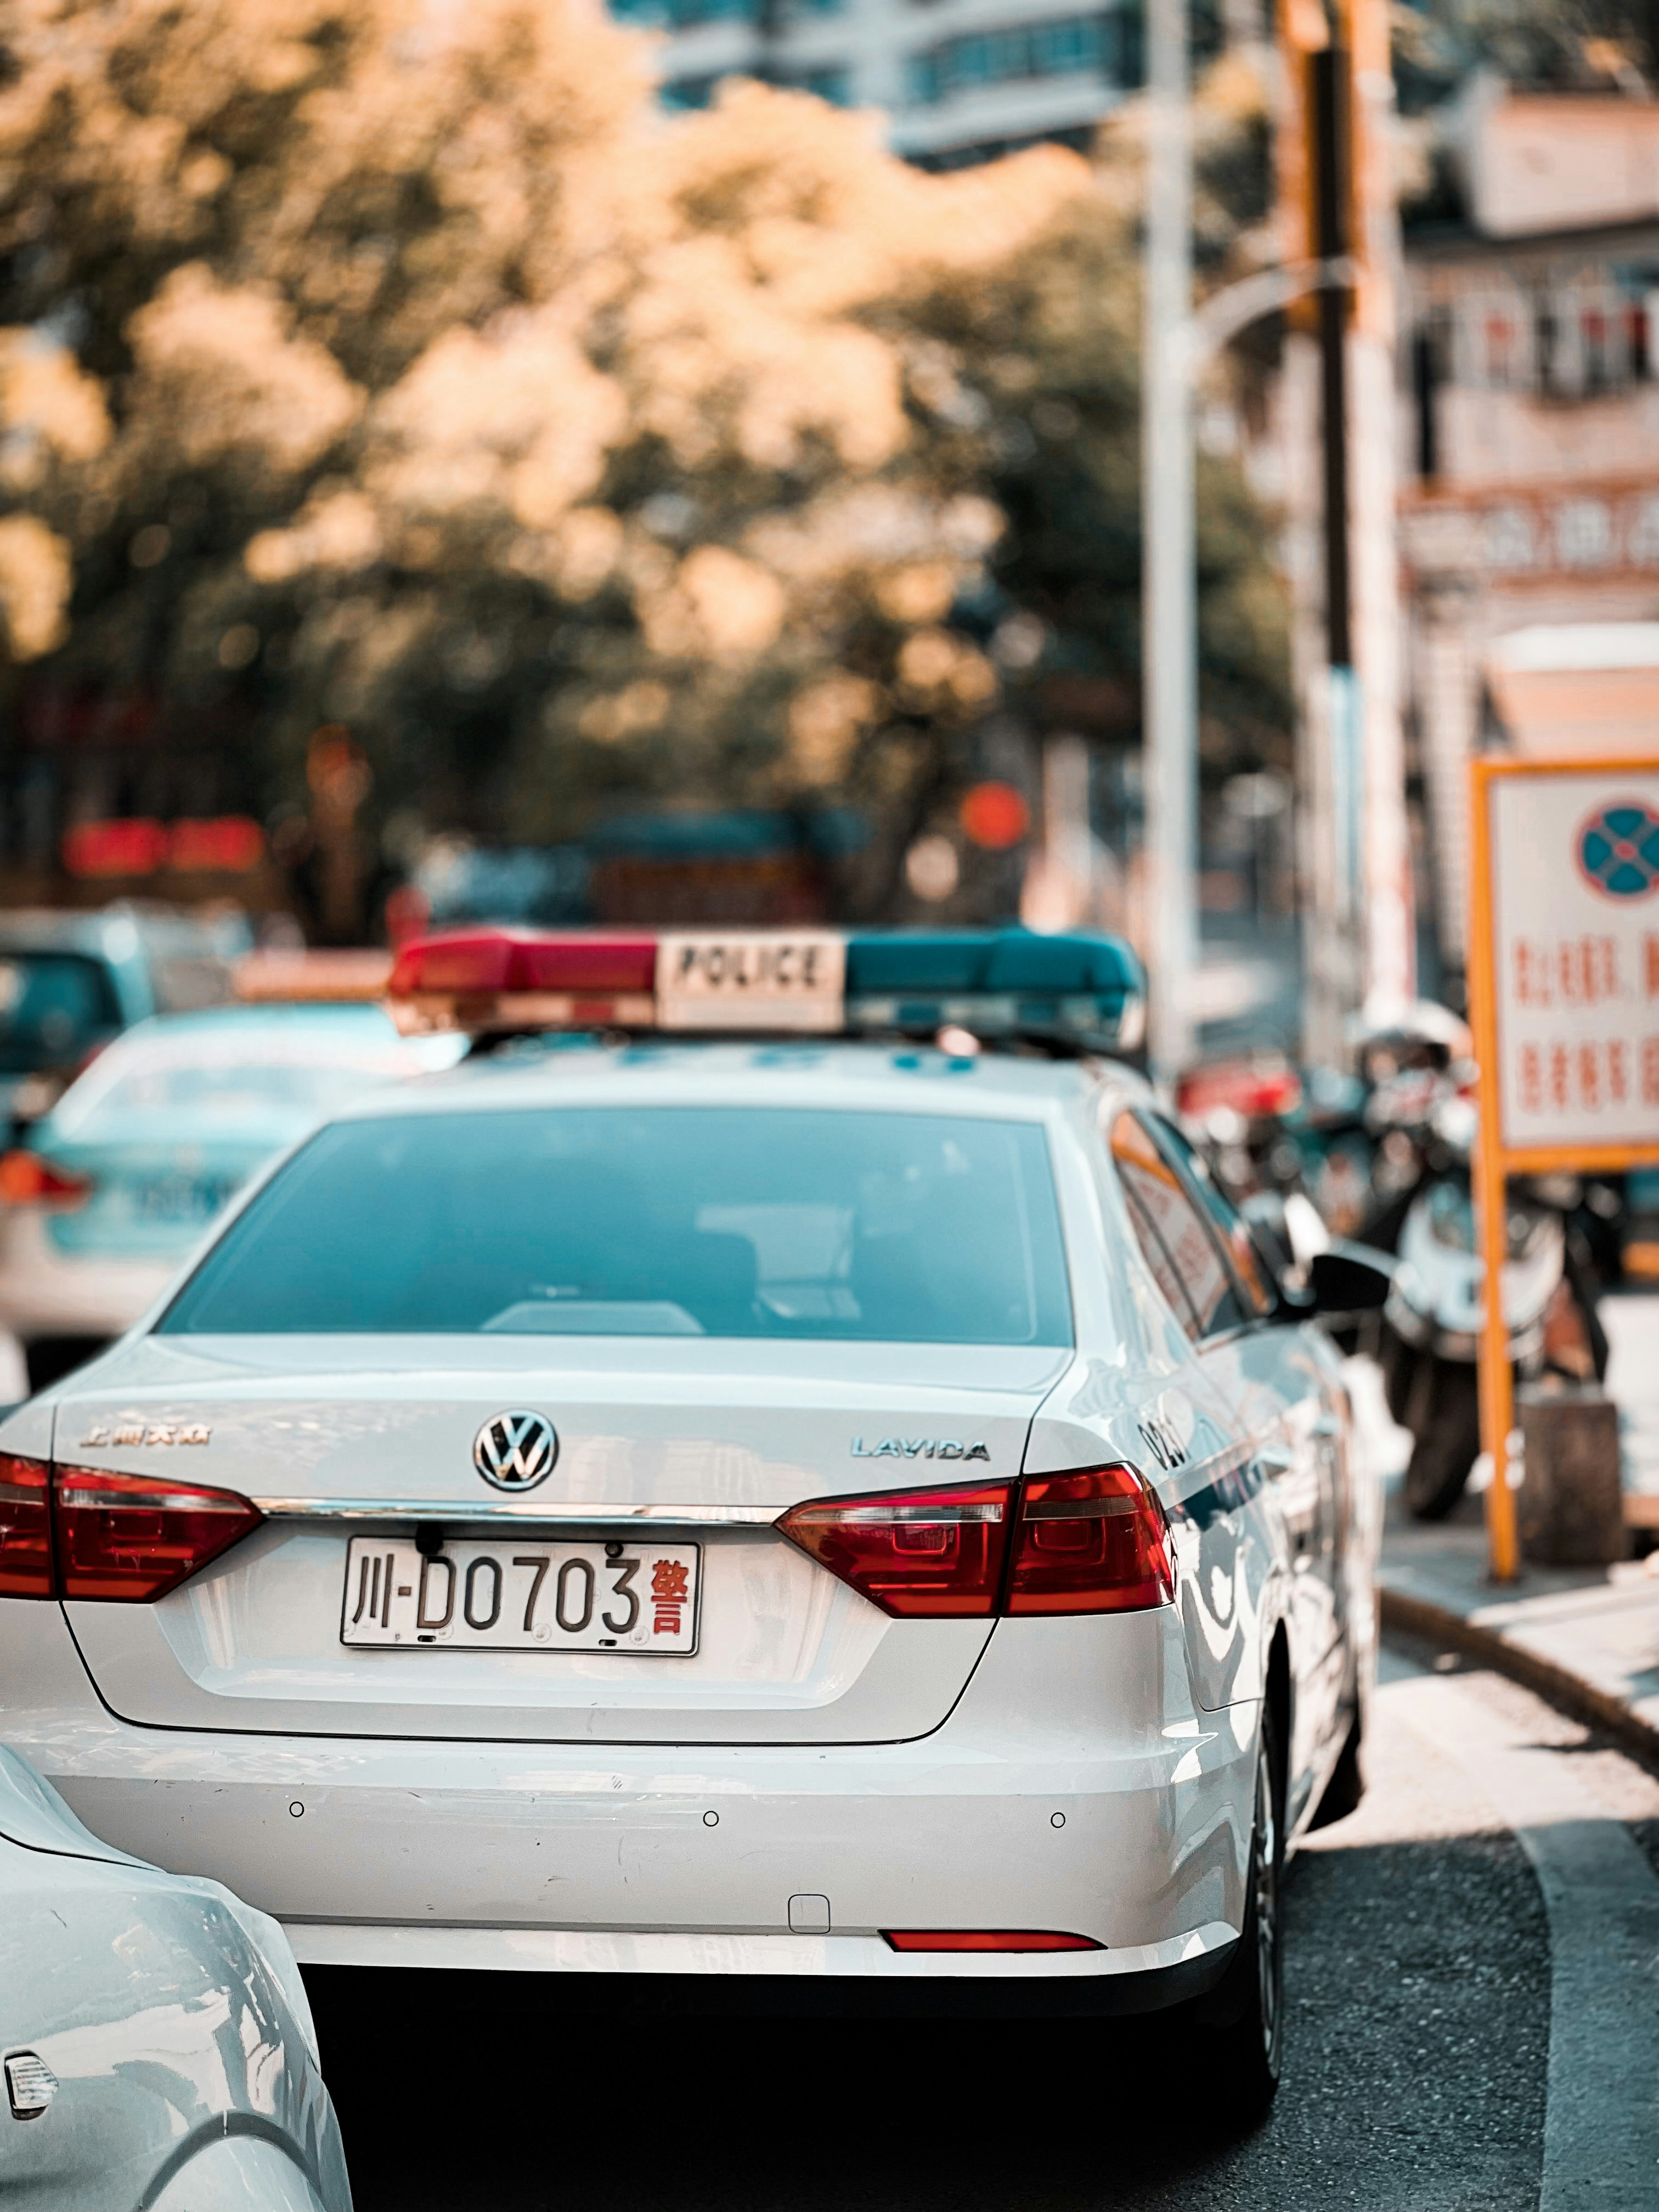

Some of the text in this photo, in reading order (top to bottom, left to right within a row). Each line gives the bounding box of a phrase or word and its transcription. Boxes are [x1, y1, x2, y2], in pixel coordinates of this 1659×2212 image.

[677, 945, 821, 988] POLICE
[475, 1409, 557, 1490] VW
[851, 1436, 990, 1462] LAVIDA
